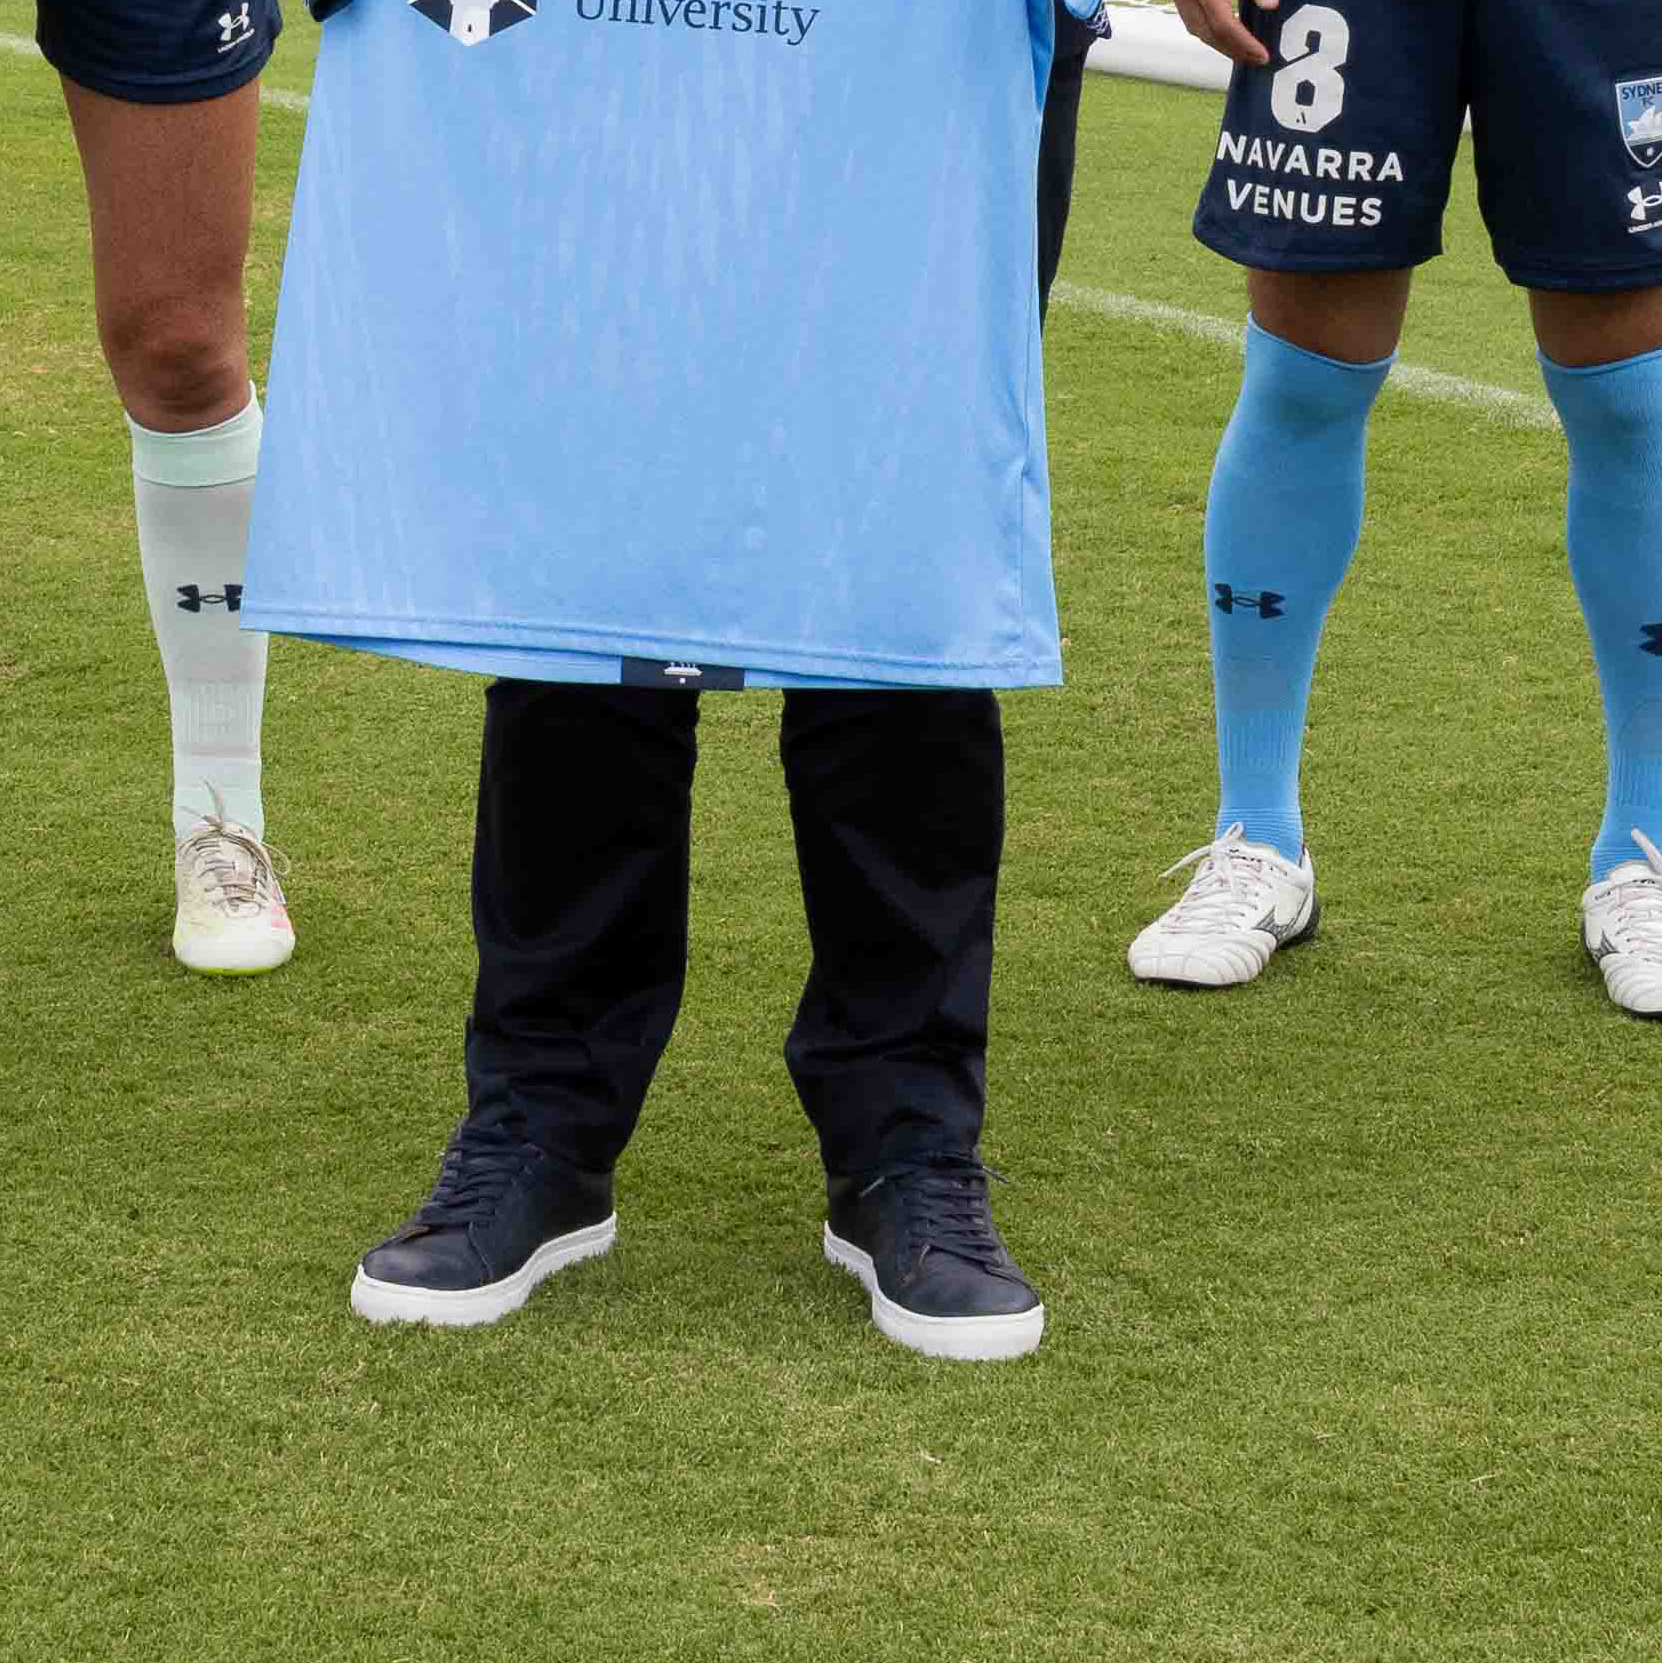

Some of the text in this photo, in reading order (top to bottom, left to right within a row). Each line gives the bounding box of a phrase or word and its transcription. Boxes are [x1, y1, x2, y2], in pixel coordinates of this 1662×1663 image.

[1271, 3, 1350, 133] 8
[1216, 131, 1404, 182] NAVARRA
[1227, 179, 1383, 226] VENUES
